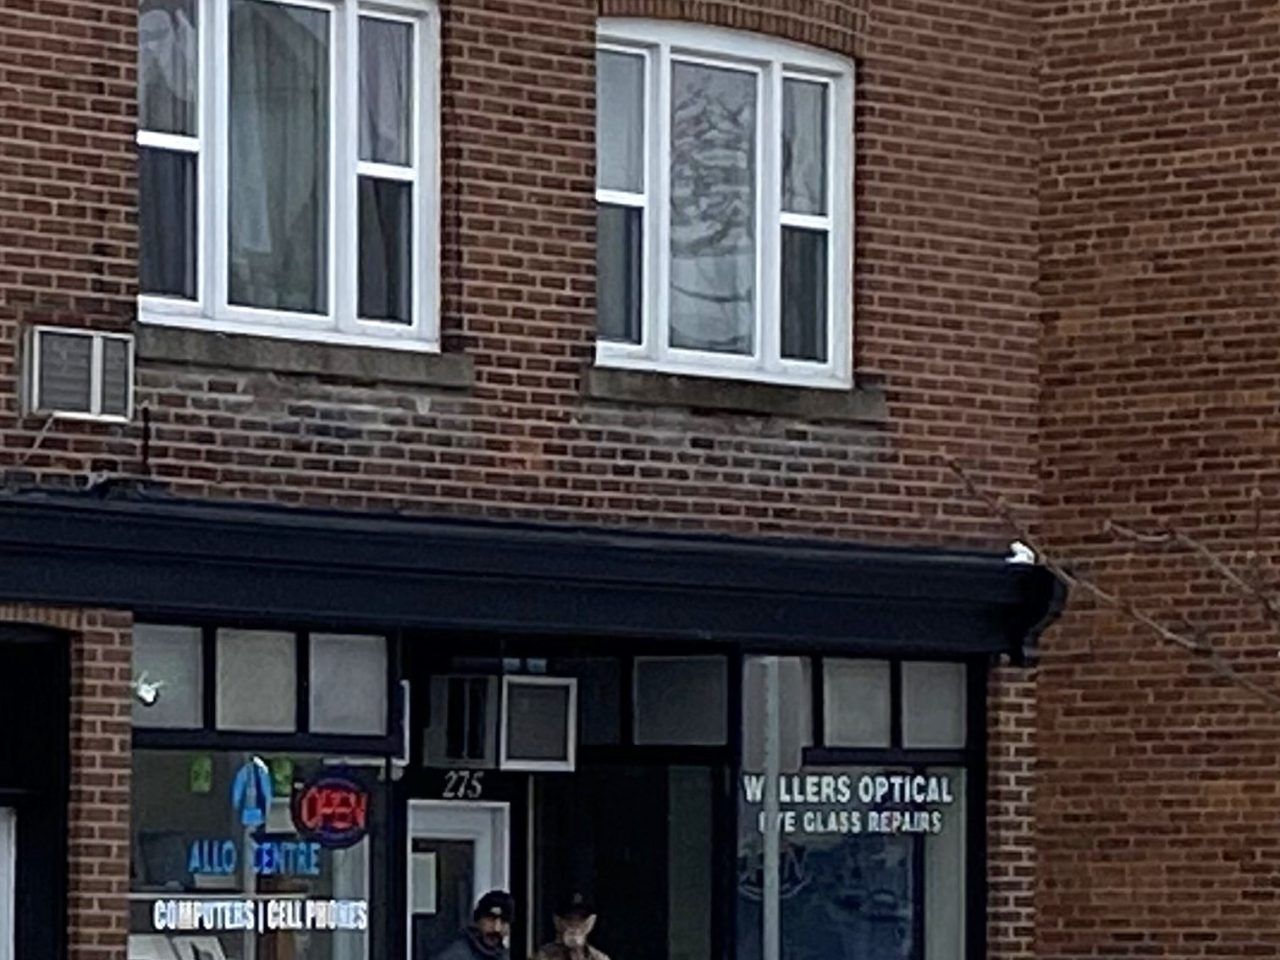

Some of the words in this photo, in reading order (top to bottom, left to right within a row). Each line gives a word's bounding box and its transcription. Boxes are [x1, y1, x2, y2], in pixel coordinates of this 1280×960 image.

[442, 771, 484, 798] 275
[743, 775, 851, 803] WLLERS
[858, 775, 953, 803] OPTICAL
[803, 811, 861, 833] GLASS
[868, 811, 942, 833] REPAIRS
[188, 840, 237, 874] ALLO
[154, 900, 255, 930] COMPUTERS
[267, 900, 303, 930] CELL
[306, 900, 367, 930] PHONES
